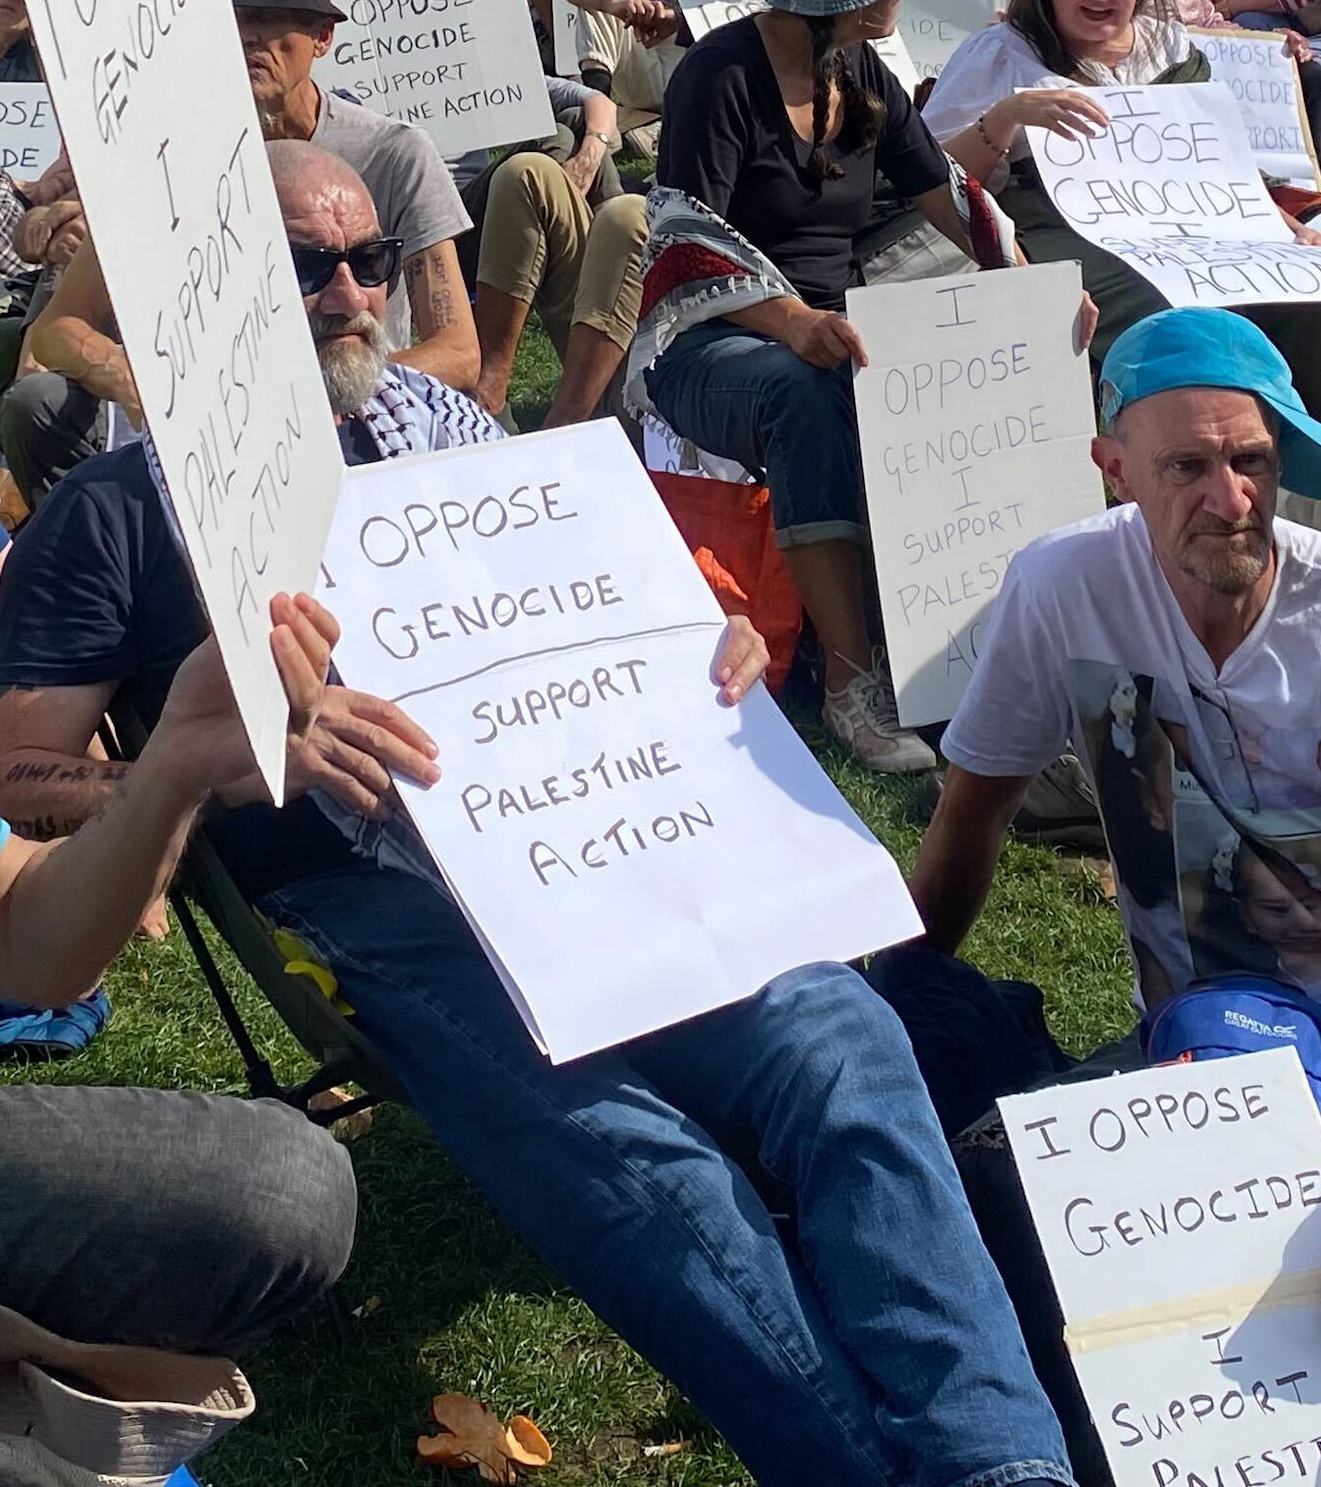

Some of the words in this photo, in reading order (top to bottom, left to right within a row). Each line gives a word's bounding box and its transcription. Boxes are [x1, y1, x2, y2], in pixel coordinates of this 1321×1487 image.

[334, 23, 477, 65] GENOCIDE
[1204, 40, 1280, 65] OPPOSE
[353, 63, 467, 100] SUPPORT
[444, 83, 523, 118] ACTION
[1105, 90, 1161, 119] I
[1044, 119, 1221, 167] OPPOSE
[1246, 125, 1300, 151] PPORT
[156, 137, 180, 232] I
[1053, 177, 1272, 225] GENOCIDE
[1150, 221, 1211, 239] I
[154, 127, 251, 420] SUPPORT
[935, 284, 977, 328] I
[183, 240, 283, 570] PALESTINE
[883, 342, 1032, 415] OPPOSE
[883, 404, 1049, 495] GENOCIDE
[229, 382, 302, 648] ACTION
[950, 465, 982, 512] I
[359, 482, 578, 568] OPPOSE
[903, 503, 1023, 566] SUPPORT
[371, 574, 624, 660] GENOCIDE
[897, 550, 1014, 627] PALEST
[472, 659, 648, 744] SUPPORT
[460, 741, 682, 833] PALESTINE
[528, 800, 715, 886] ACTION
[1224, 1010, 1272, 1036] REGATTA
[1023, 1117, 1071, 1161] I
[1089, 1084, 1270, 1153] OPPOSE
[1201, 1326, 1243, 1365] I
[1110, 1371, 1309, 1447] SUPPORT
